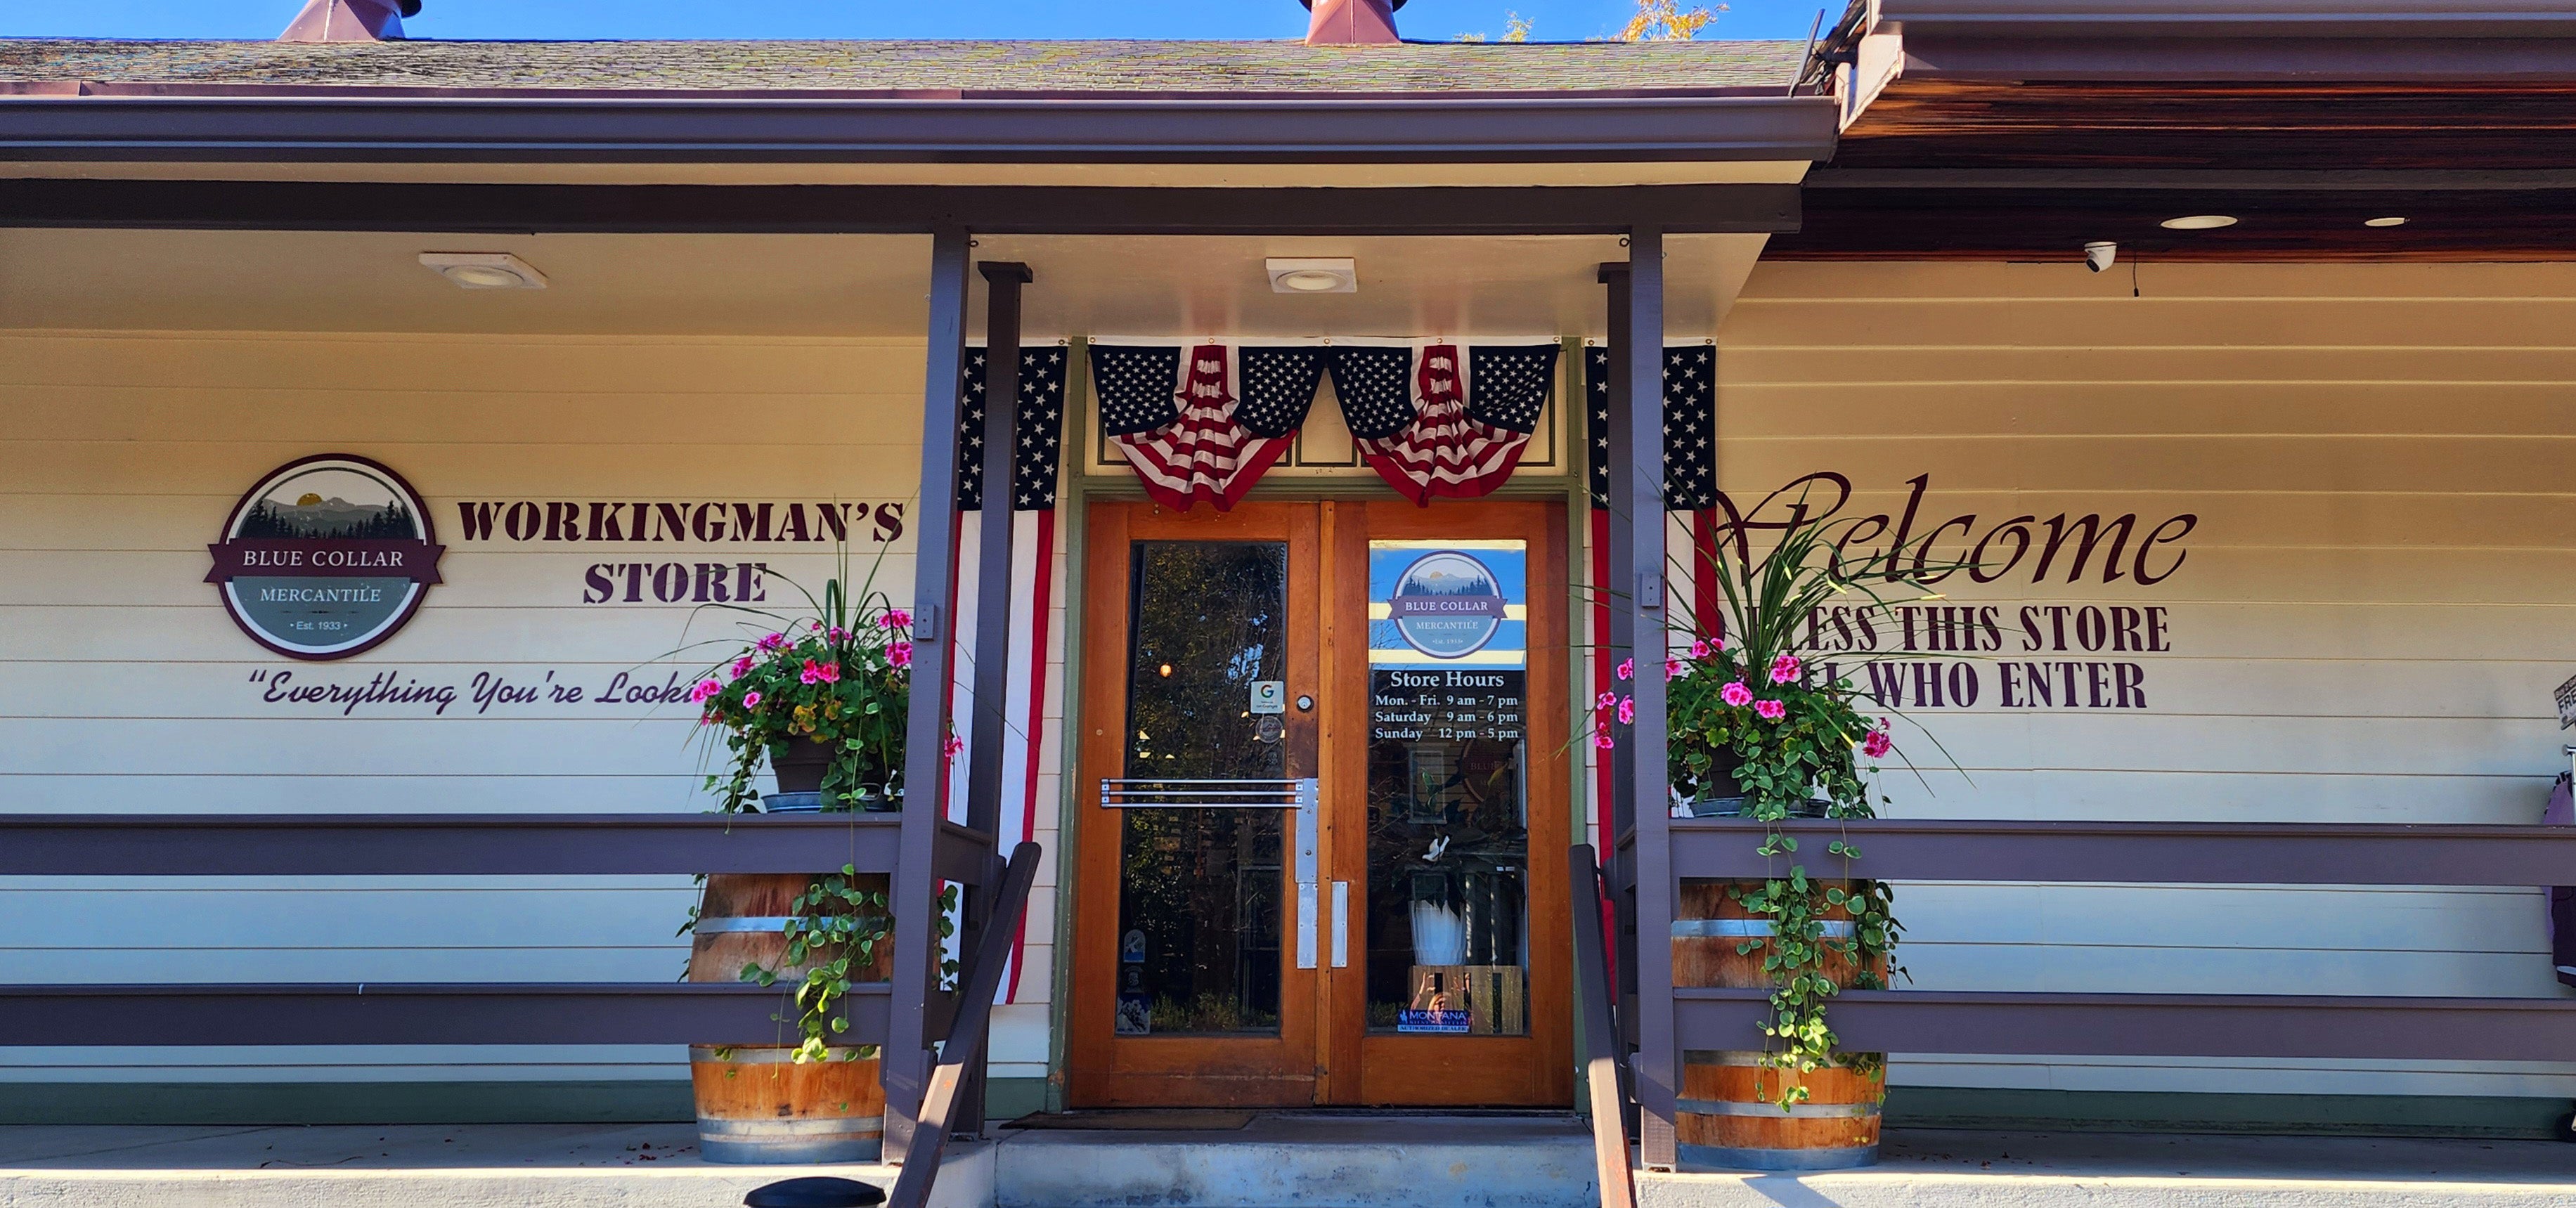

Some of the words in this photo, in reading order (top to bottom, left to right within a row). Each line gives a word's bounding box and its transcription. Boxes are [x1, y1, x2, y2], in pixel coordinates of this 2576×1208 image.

[457, 501, 904, 542] WORKINGMAN'S
[1716, 471, 2199, 586] Welcome
[242, 550, 303, 566] BLUE
[312, 550, 403, 567] COLLAR
[583, 562, 766, 604] STORE
[259, 587, 381, 602] MERCANTILE
[1405, 602, 1437, 611] BLUE
[1439, 601, 1488, 611] COLLAR
[296, 621, 313, 630] Est.
[318, 621, 342, 630] 1933
[1416, 621, 1479, 630] MERCANTILE
[1895, 606, 2003, 651] THIS
[2020, 605, 2170, 652] STORE
[1390, 671, 1440, 687] Store
[1445, 671, 1505, 687] Hours
[1869, 662, 1979, 708] WHO
[2000, 662, 2148, 708] ENTER
[249, 670, 458, 716] "Everything
[471, 670, 583, 714] You're
[1375, 694, 1409, 706] Mon.
[1419, 694, 1441, 706] Fri.
[1446, 695, 1454, 706] 9
[1457, 697, 1476, 706] am
[1487, 695, 1495, 706] 7
[1498, 697, 1518, 709] pm
[1375, 710, 1432, 726] Saturday
[1446, 711, 1454, 722] 9
[1457, 713, 1476, 722] am
[1487, 711, 1494, 722] 6
[1498, 713, 1518, 725] pm
[1375, 727, 1423, 742] Sunday
[1439, 727, 1453, 739] 12
[1456, 730, 1477, 741] pm
[1487, 727, 1495, 739] 5
[1498, 730, 1519, 741] pm
